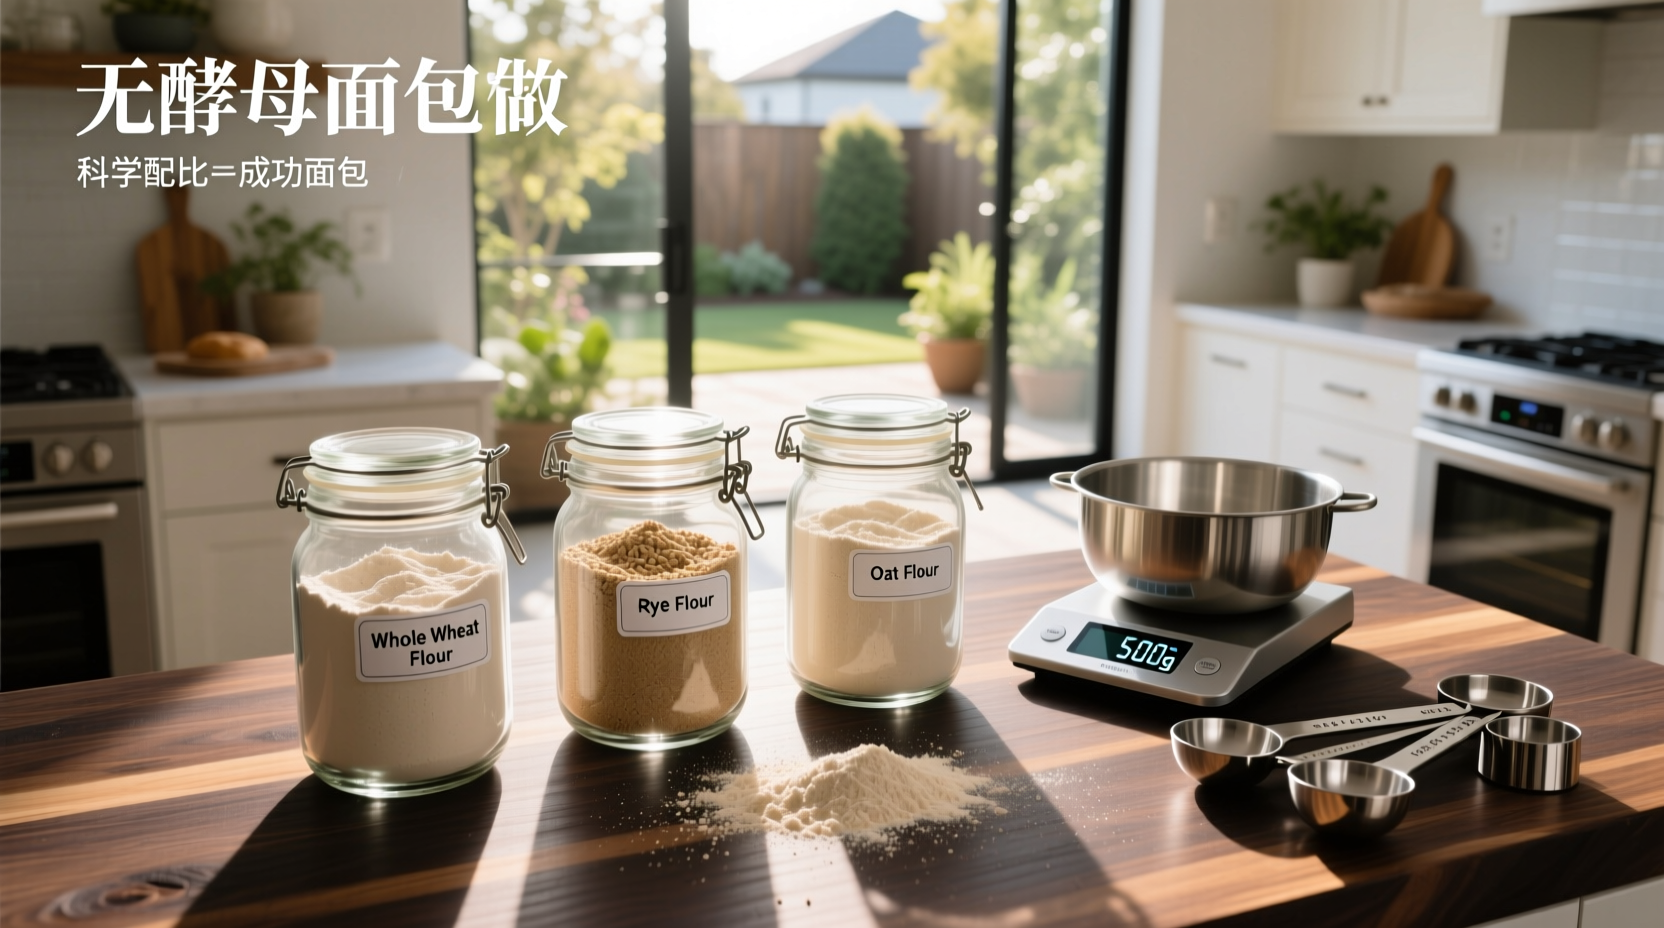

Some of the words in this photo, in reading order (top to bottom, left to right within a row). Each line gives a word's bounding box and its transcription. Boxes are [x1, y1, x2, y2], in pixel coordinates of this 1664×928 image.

[870, 565, 899, 581] Oat
[903, 563, 941, 580] Flour
[638, 597, 670, 617] Rye
[675, 592, 715, 612] Flour
[371, 629, 427, 649] Whole
[430, 619, 480, 643] Wheat
[410, 649, 453, 667] Flour
[1115, 635, 1177, 673] 500g
